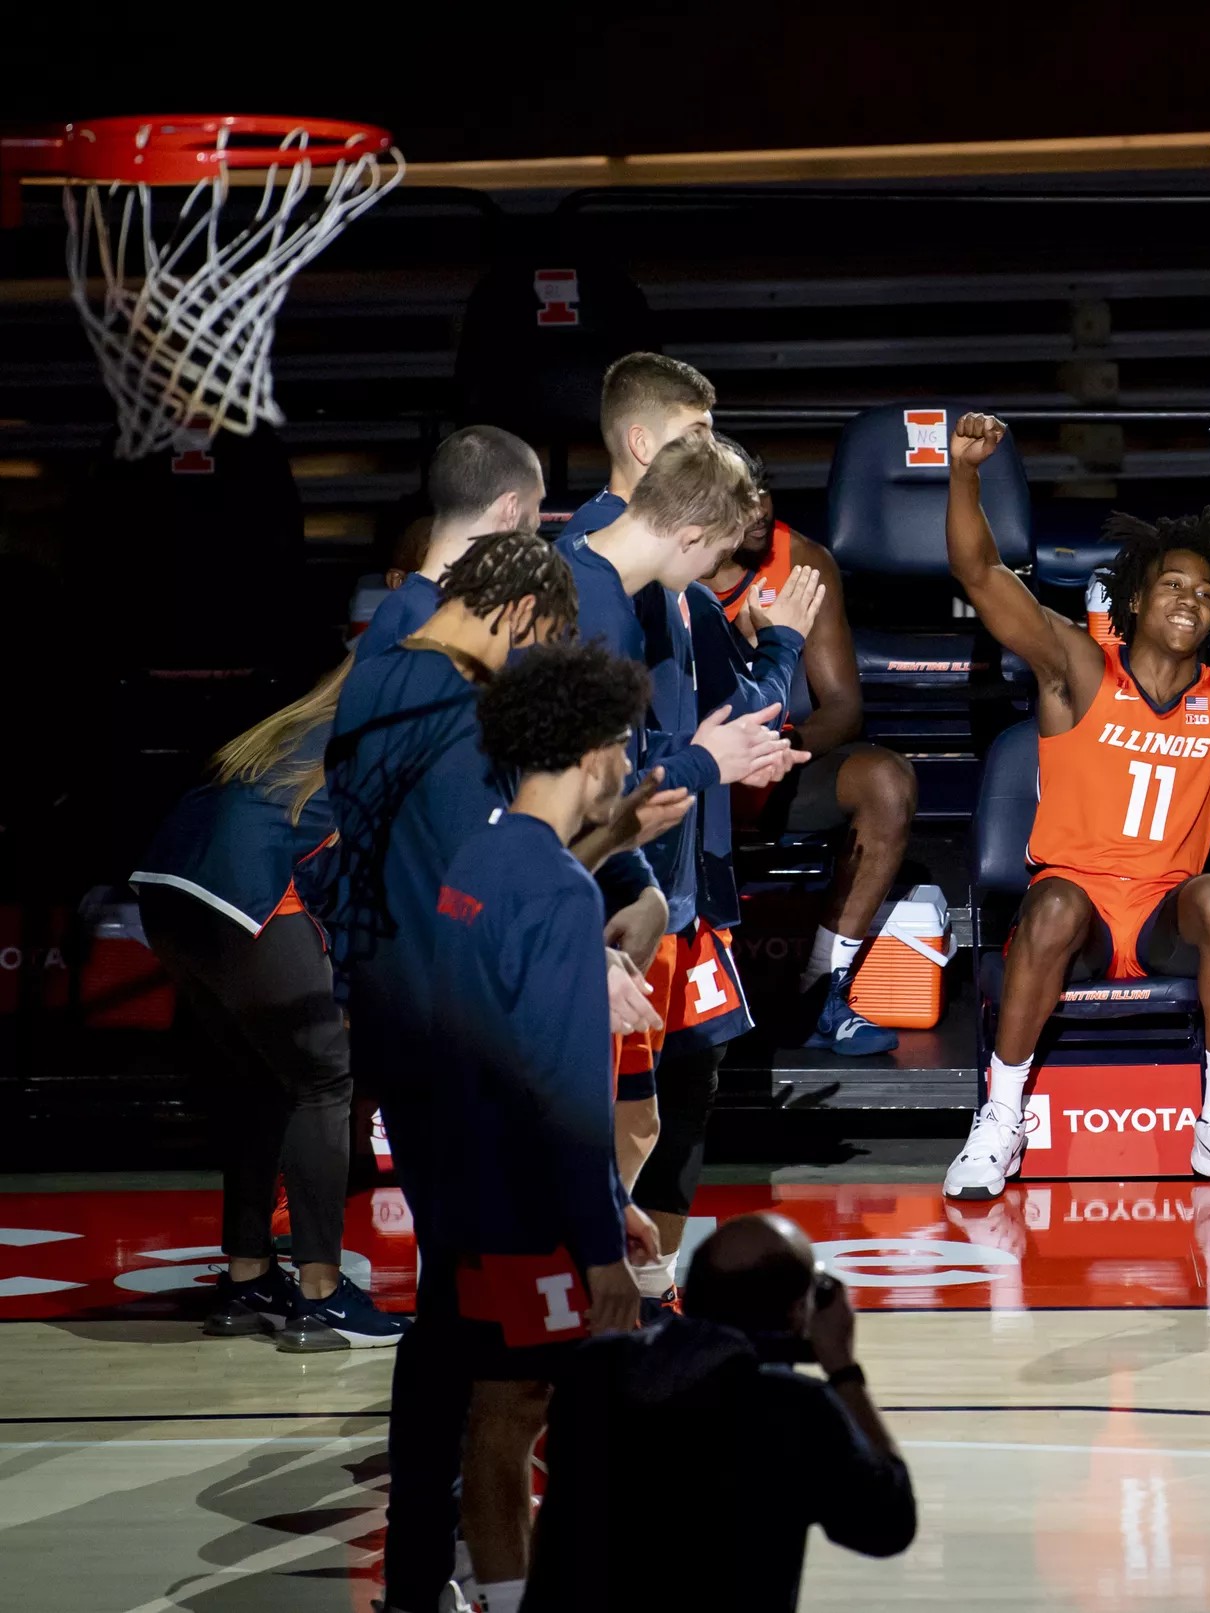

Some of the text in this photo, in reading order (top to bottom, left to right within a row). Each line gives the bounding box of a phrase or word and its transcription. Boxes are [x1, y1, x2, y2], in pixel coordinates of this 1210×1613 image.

[917, 429, 938, 444] NG
[1097, 723, 1210, 758] ILLINOIS
[1122, 760, 1176, 841] 11
[686, 958, 727, 1014] I
[1063, 1108, 1195, 1133] TOYOTA
[536, 1272, 581, 1333] I
